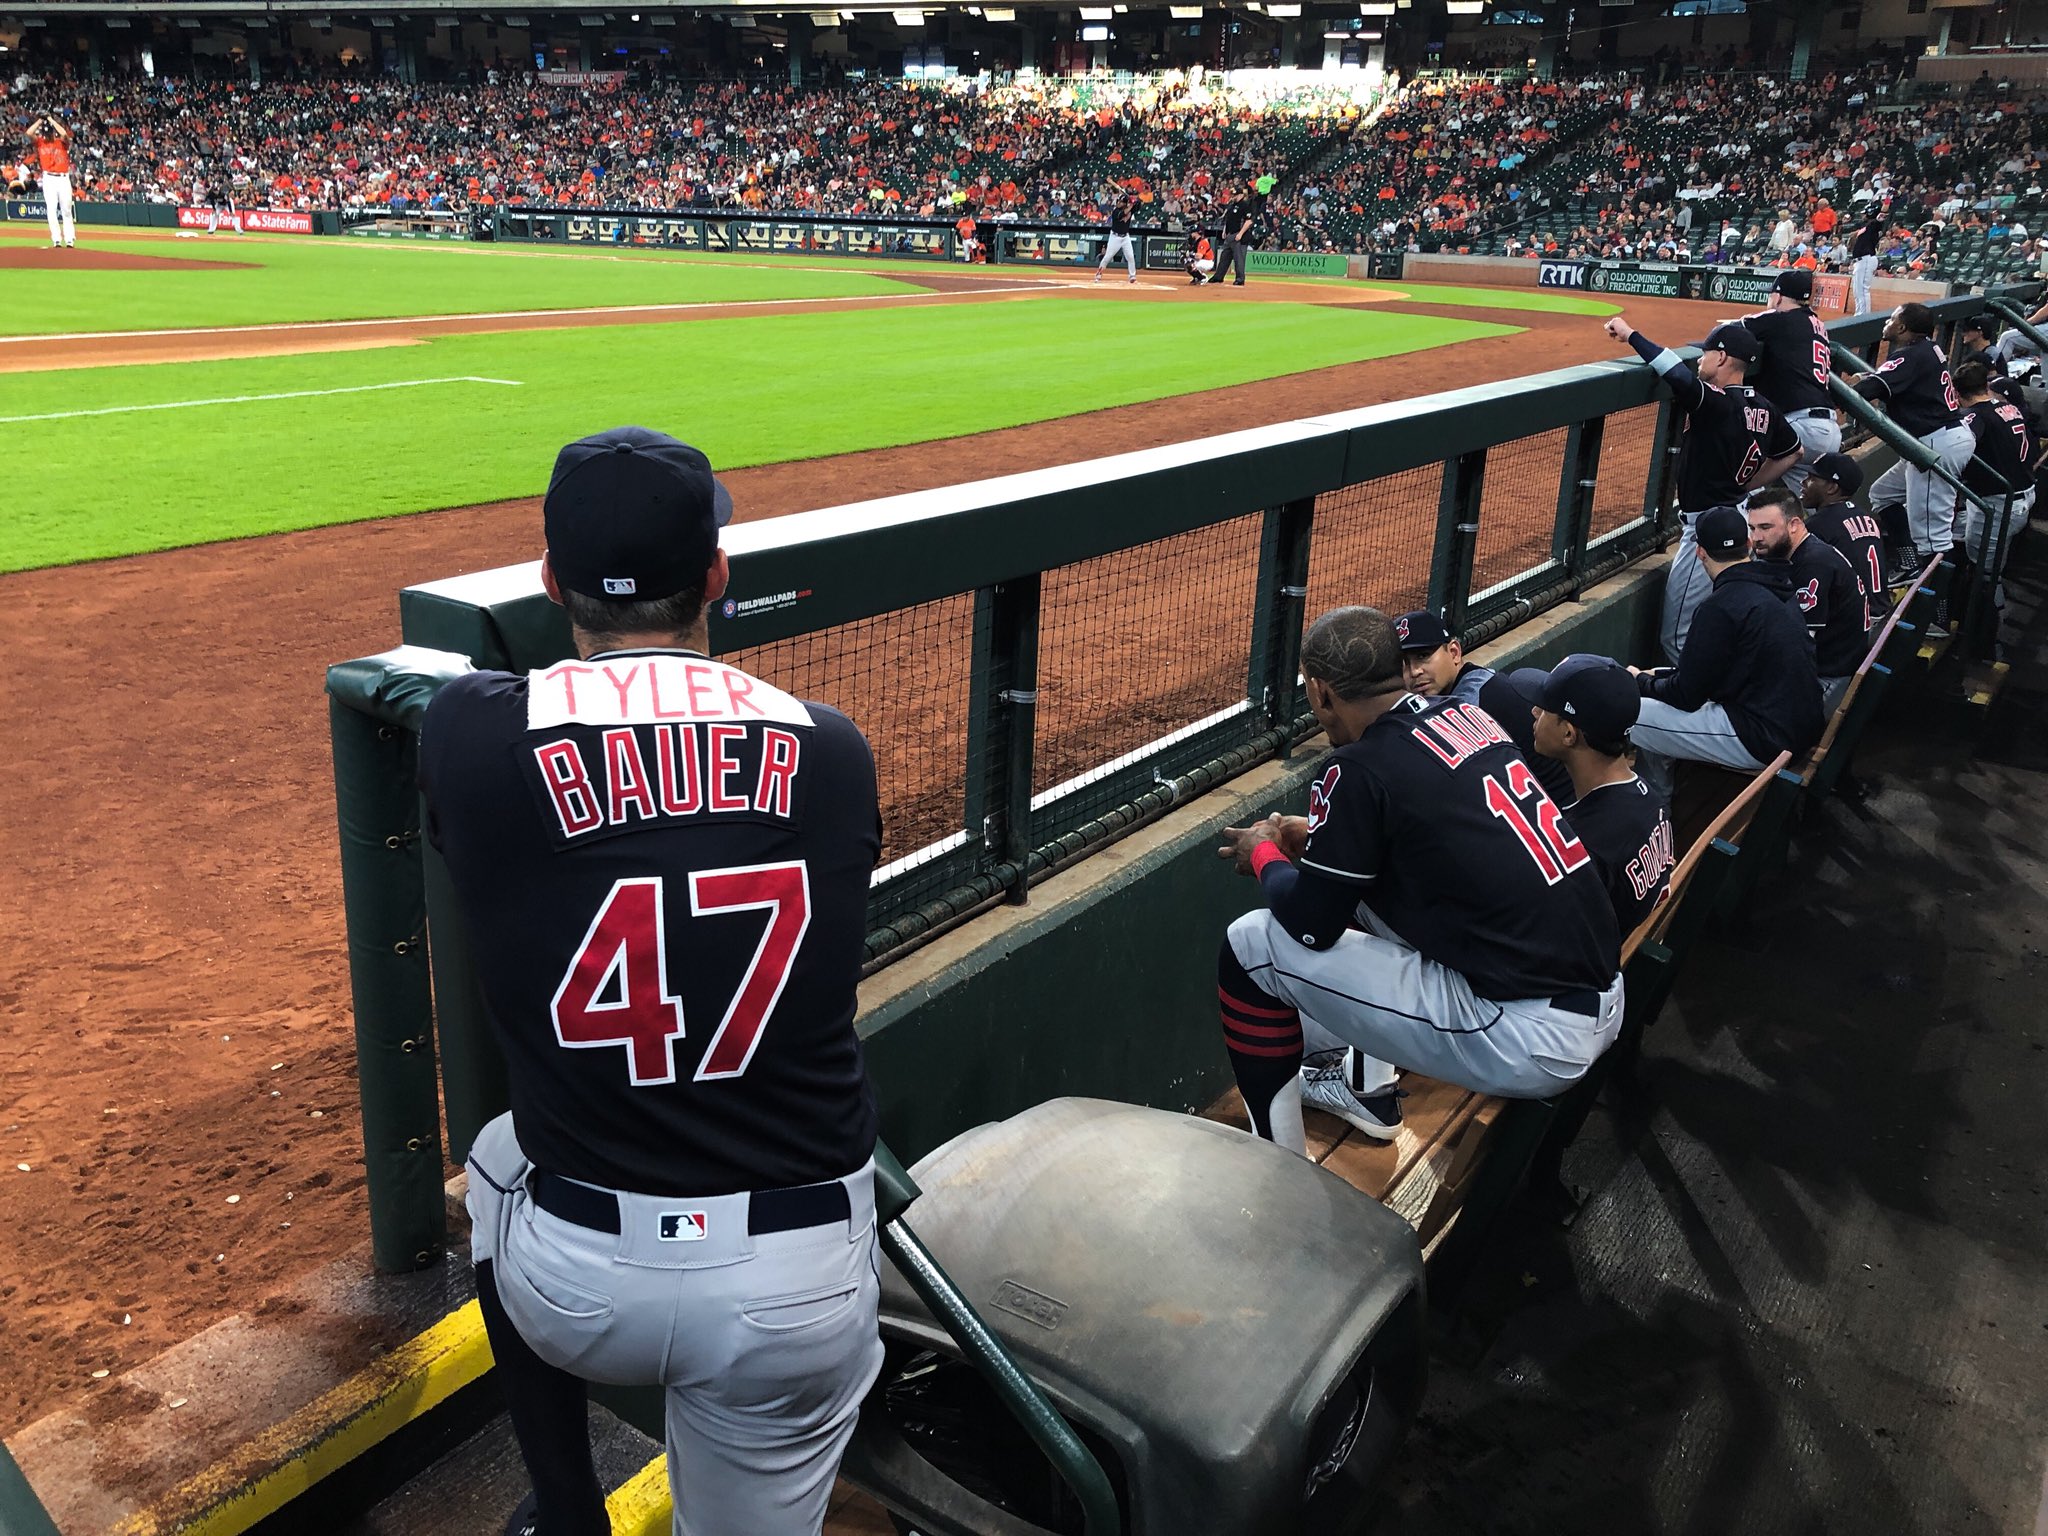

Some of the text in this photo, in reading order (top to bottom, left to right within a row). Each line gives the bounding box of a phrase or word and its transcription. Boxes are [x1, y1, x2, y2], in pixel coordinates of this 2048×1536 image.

[553, 73, 588, 84] OFFICIAL
[1252, 254, 1328, 268] WOODFOREST
[1610, 272, 1668, 285] OLD DOMINION
[1609, 282, 1641, 292] FREIGHT
[1662, 285, 1677, 295] INC
[1727, 290, 1757, 302] FREIGHT
[1728, 279, 1744, 289] OLD
[1830, 297, 1839, 309] ALL
[1941, 371, 1959, 411] 2
[2012, 423, 2029, 462] 7
[1735, 440, 1761, 485] 6
[1868, 545, 1881, 593] 1
[546, 663, 765, 718] TYLER
[533, 723, 800, 838] BAUER
[1483, 759, 1591, 886] 12
[550, 859, 812, 1086] 47
